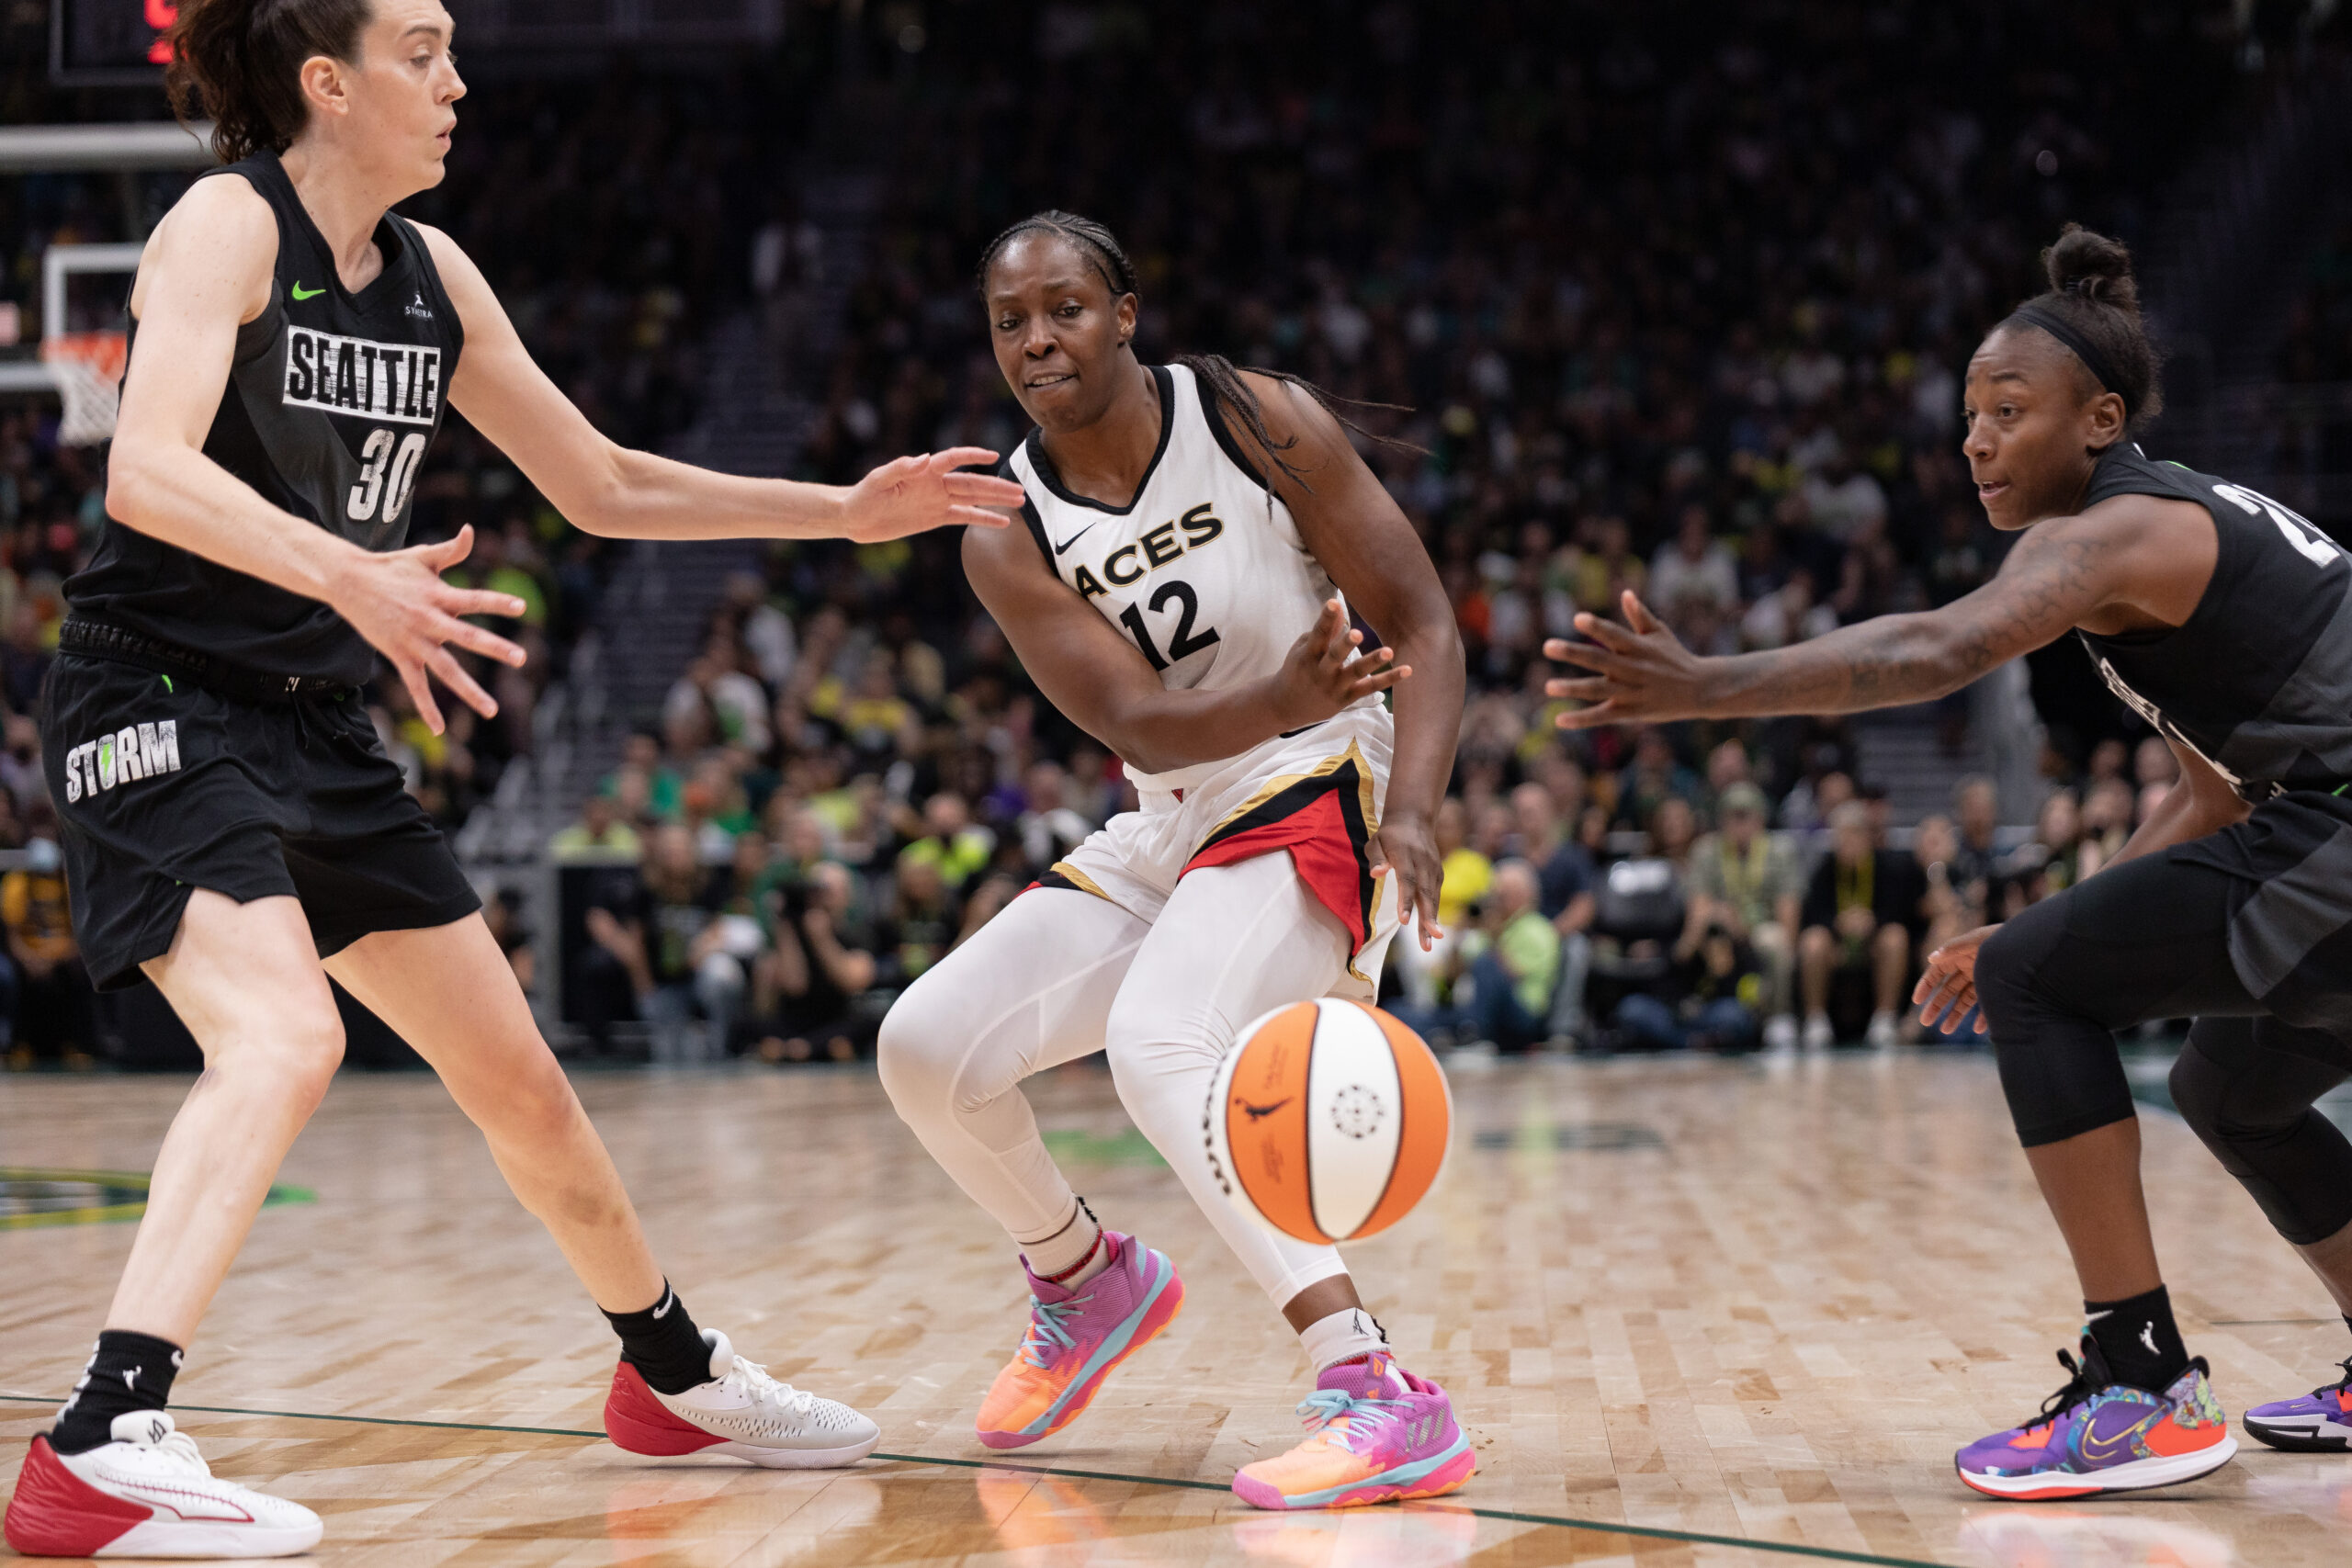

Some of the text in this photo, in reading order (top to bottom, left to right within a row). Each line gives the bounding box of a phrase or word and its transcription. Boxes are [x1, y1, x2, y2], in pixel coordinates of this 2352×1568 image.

[288, 331, 439, 420] SEATTLE
[346, 428, 426, 524] 30
[1073, 501, 1226, 602] ACES
[2211, 483, 2342, 570] 2
[1118, 580, 1221, 672] 12
[65, 719, 182, 805] STORM
